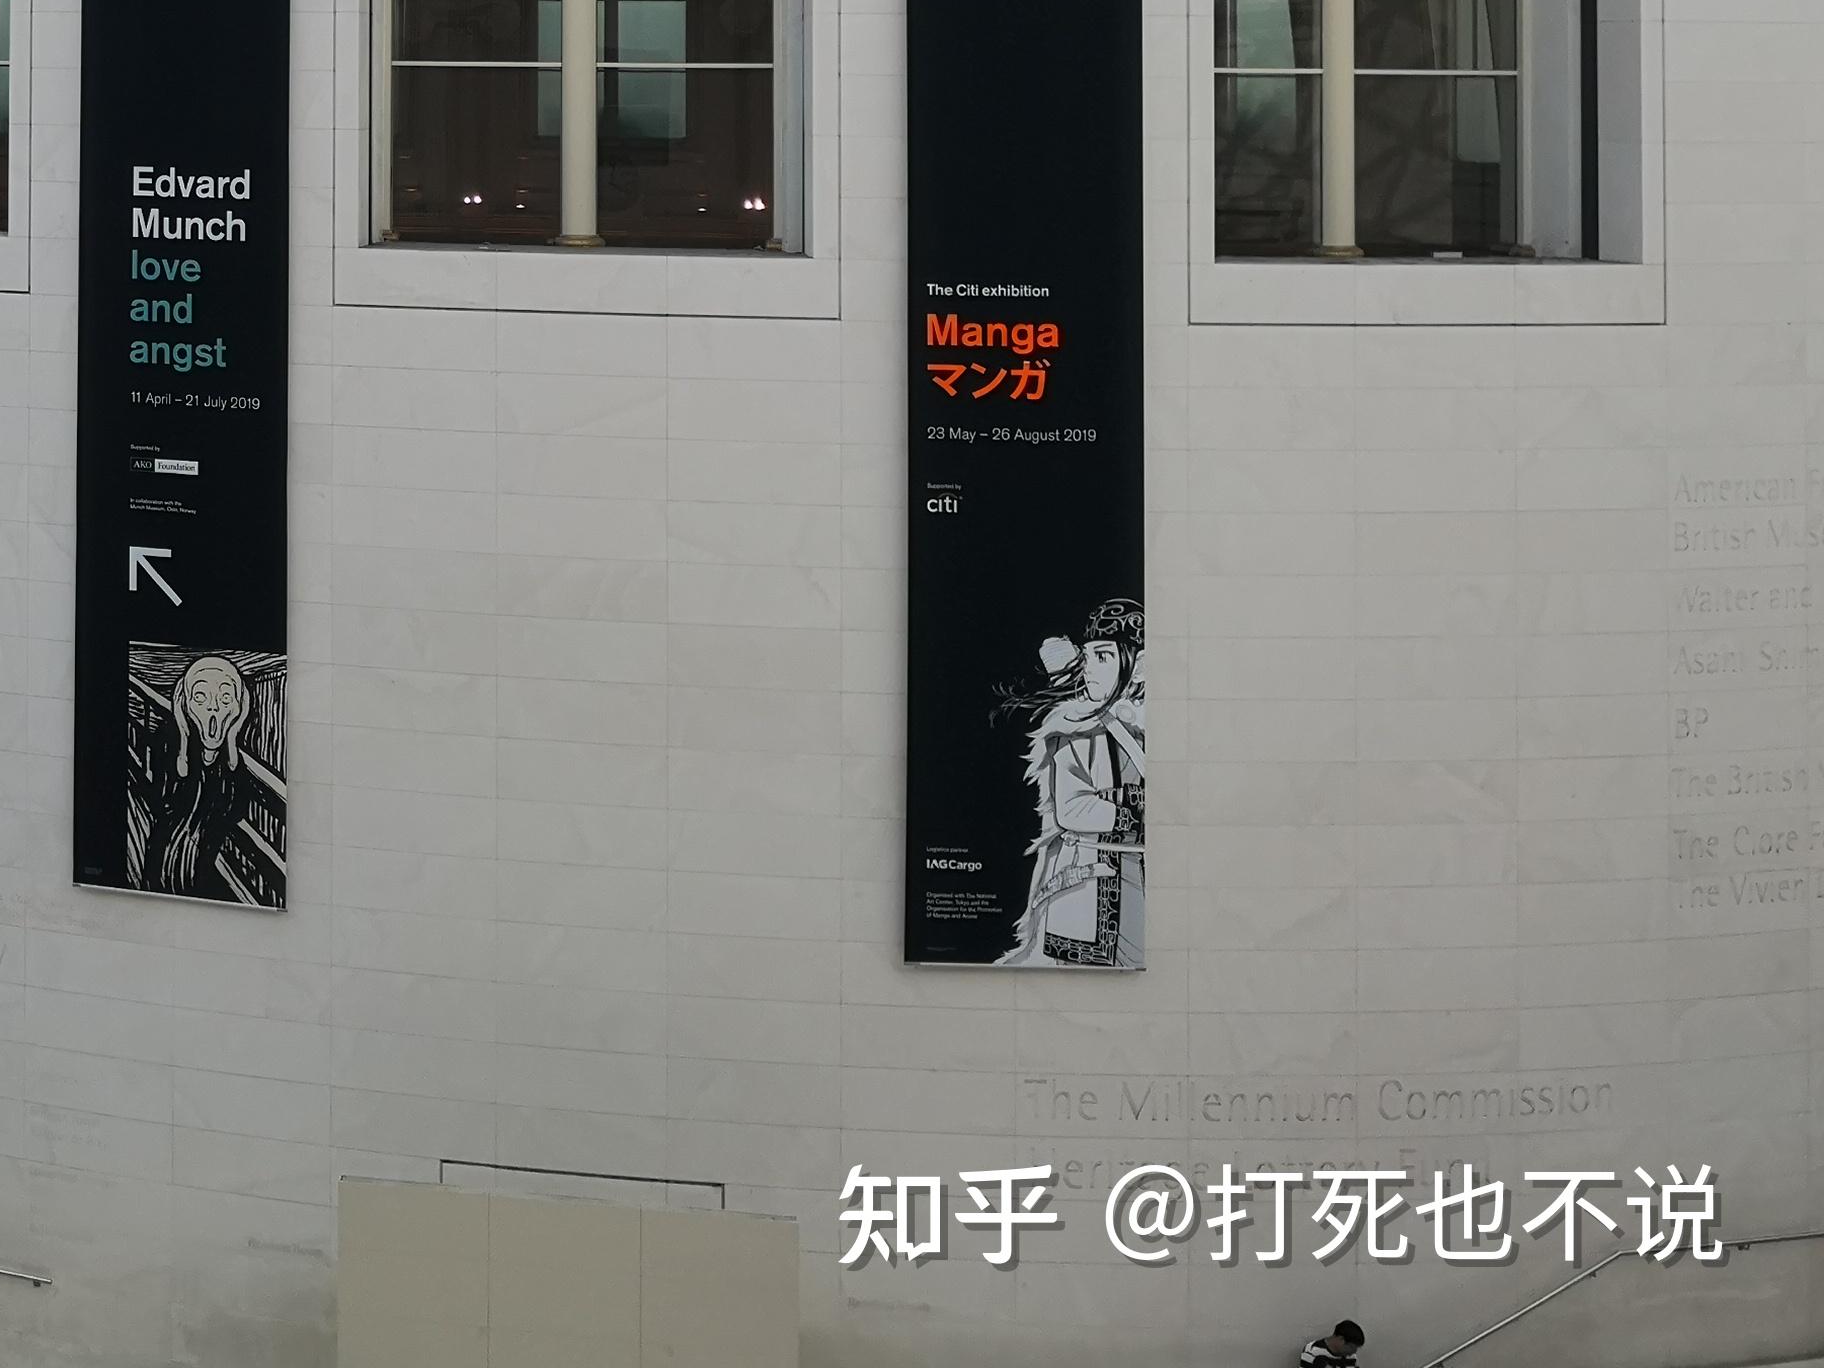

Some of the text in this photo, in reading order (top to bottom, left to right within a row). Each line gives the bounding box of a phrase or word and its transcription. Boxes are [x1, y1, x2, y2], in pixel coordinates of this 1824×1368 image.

[132, 165, 251, 200] Edvard
[131, 207, 247, 242] Munch
[131, 249, 202, 282] love
[926, 283, 1050, 297] The Citi exhibition
[129, 293, 193, 324] and
[927, 313, 1059, 354] Manga
[129, 337, 227, 373] angst
[927, 358, 1051, 400] マンガ
[130, 391, 141, 403] 11
[145, 392, 172, 407] April
[185, 394, 200, 406] 21
[204, 395, 227, 411] July
[230, 396, 261, 410] 2019
[927, 426, 945, 440] 23
[949, 427, 977, 444] May
[991, 428, 1011, 441] 26
[1014, 428, 1060, 444] August
[1063, 429, 1097, 442] 2019
[133, 460, 196, 472] AKO Foundation
[927, 494, 958, 513] citi
[1674, 707, 1710, 739] BP
[1672, 828, 1719, 860] The
[1023, 1077, 1613, 1123] The Millennium Commission
